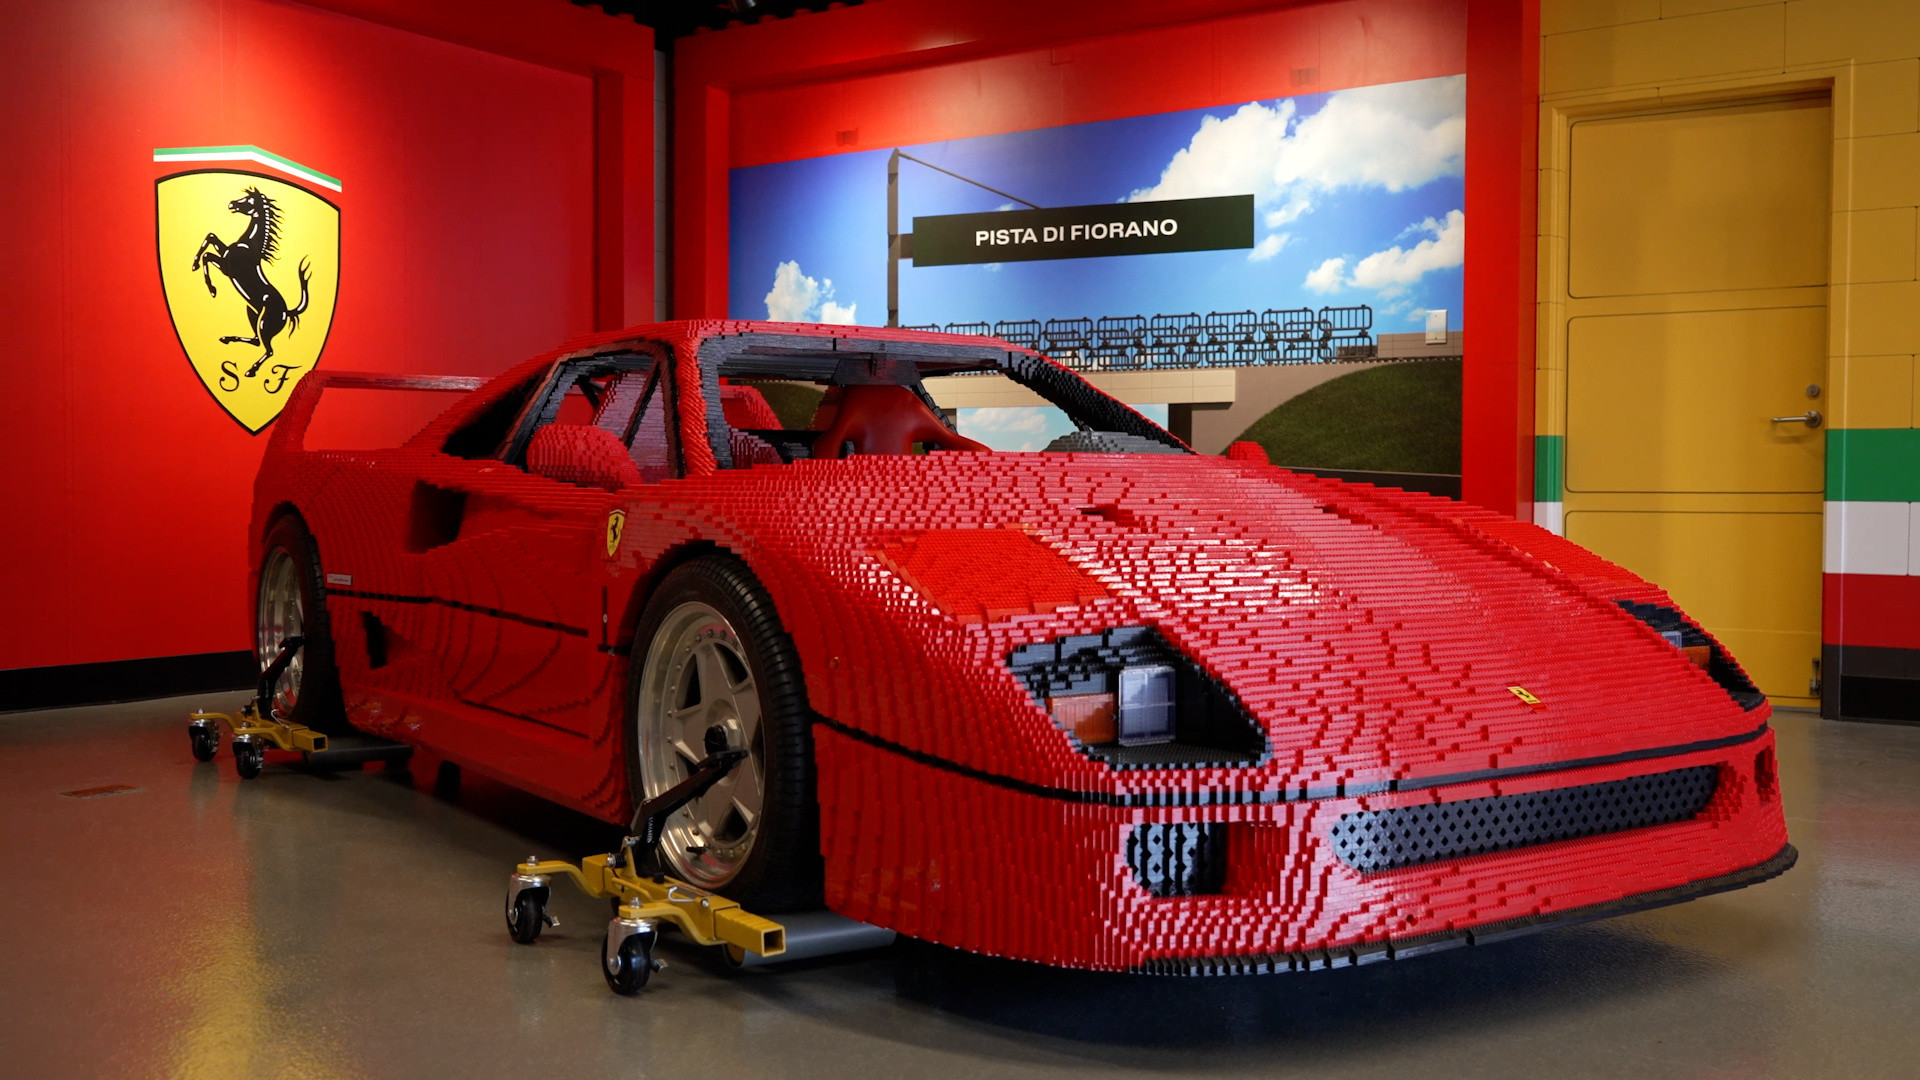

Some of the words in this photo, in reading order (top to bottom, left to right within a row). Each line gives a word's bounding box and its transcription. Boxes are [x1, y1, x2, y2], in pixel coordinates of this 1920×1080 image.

[975, 228, 1038, 247] PISTA
[1043, 226, 1066, 243] DI
[1070, 218, 1178, 241] FIORANO
[219, 361, 240, 392] S
[263, 364, 303, 394] F
